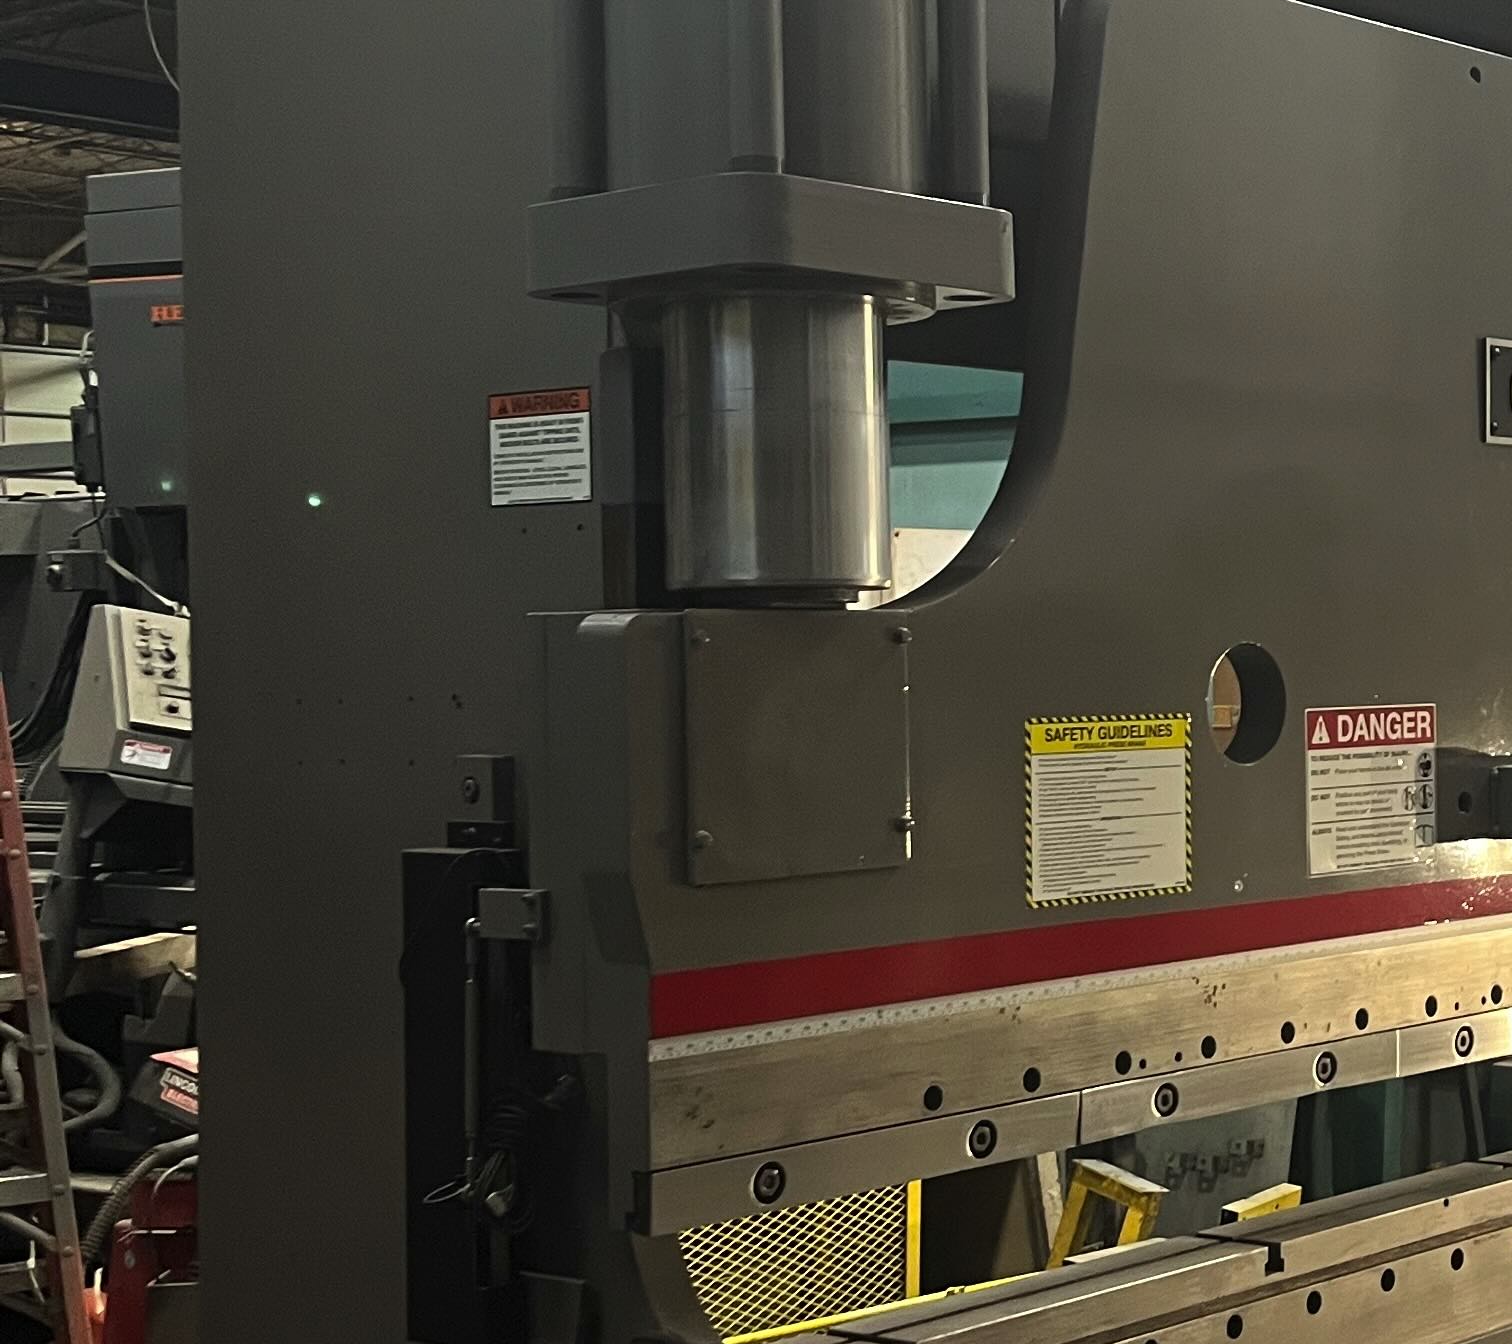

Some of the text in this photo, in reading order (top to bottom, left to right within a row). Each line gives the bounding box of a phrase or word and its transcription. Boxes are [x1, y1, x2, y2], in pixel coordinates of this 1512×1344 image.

[511, 391, 580, 413] WARNING
[1044, 723, 1173, 742] SAFETY GUIDELINES
[1337, 710, 1431, 743] DANGER
